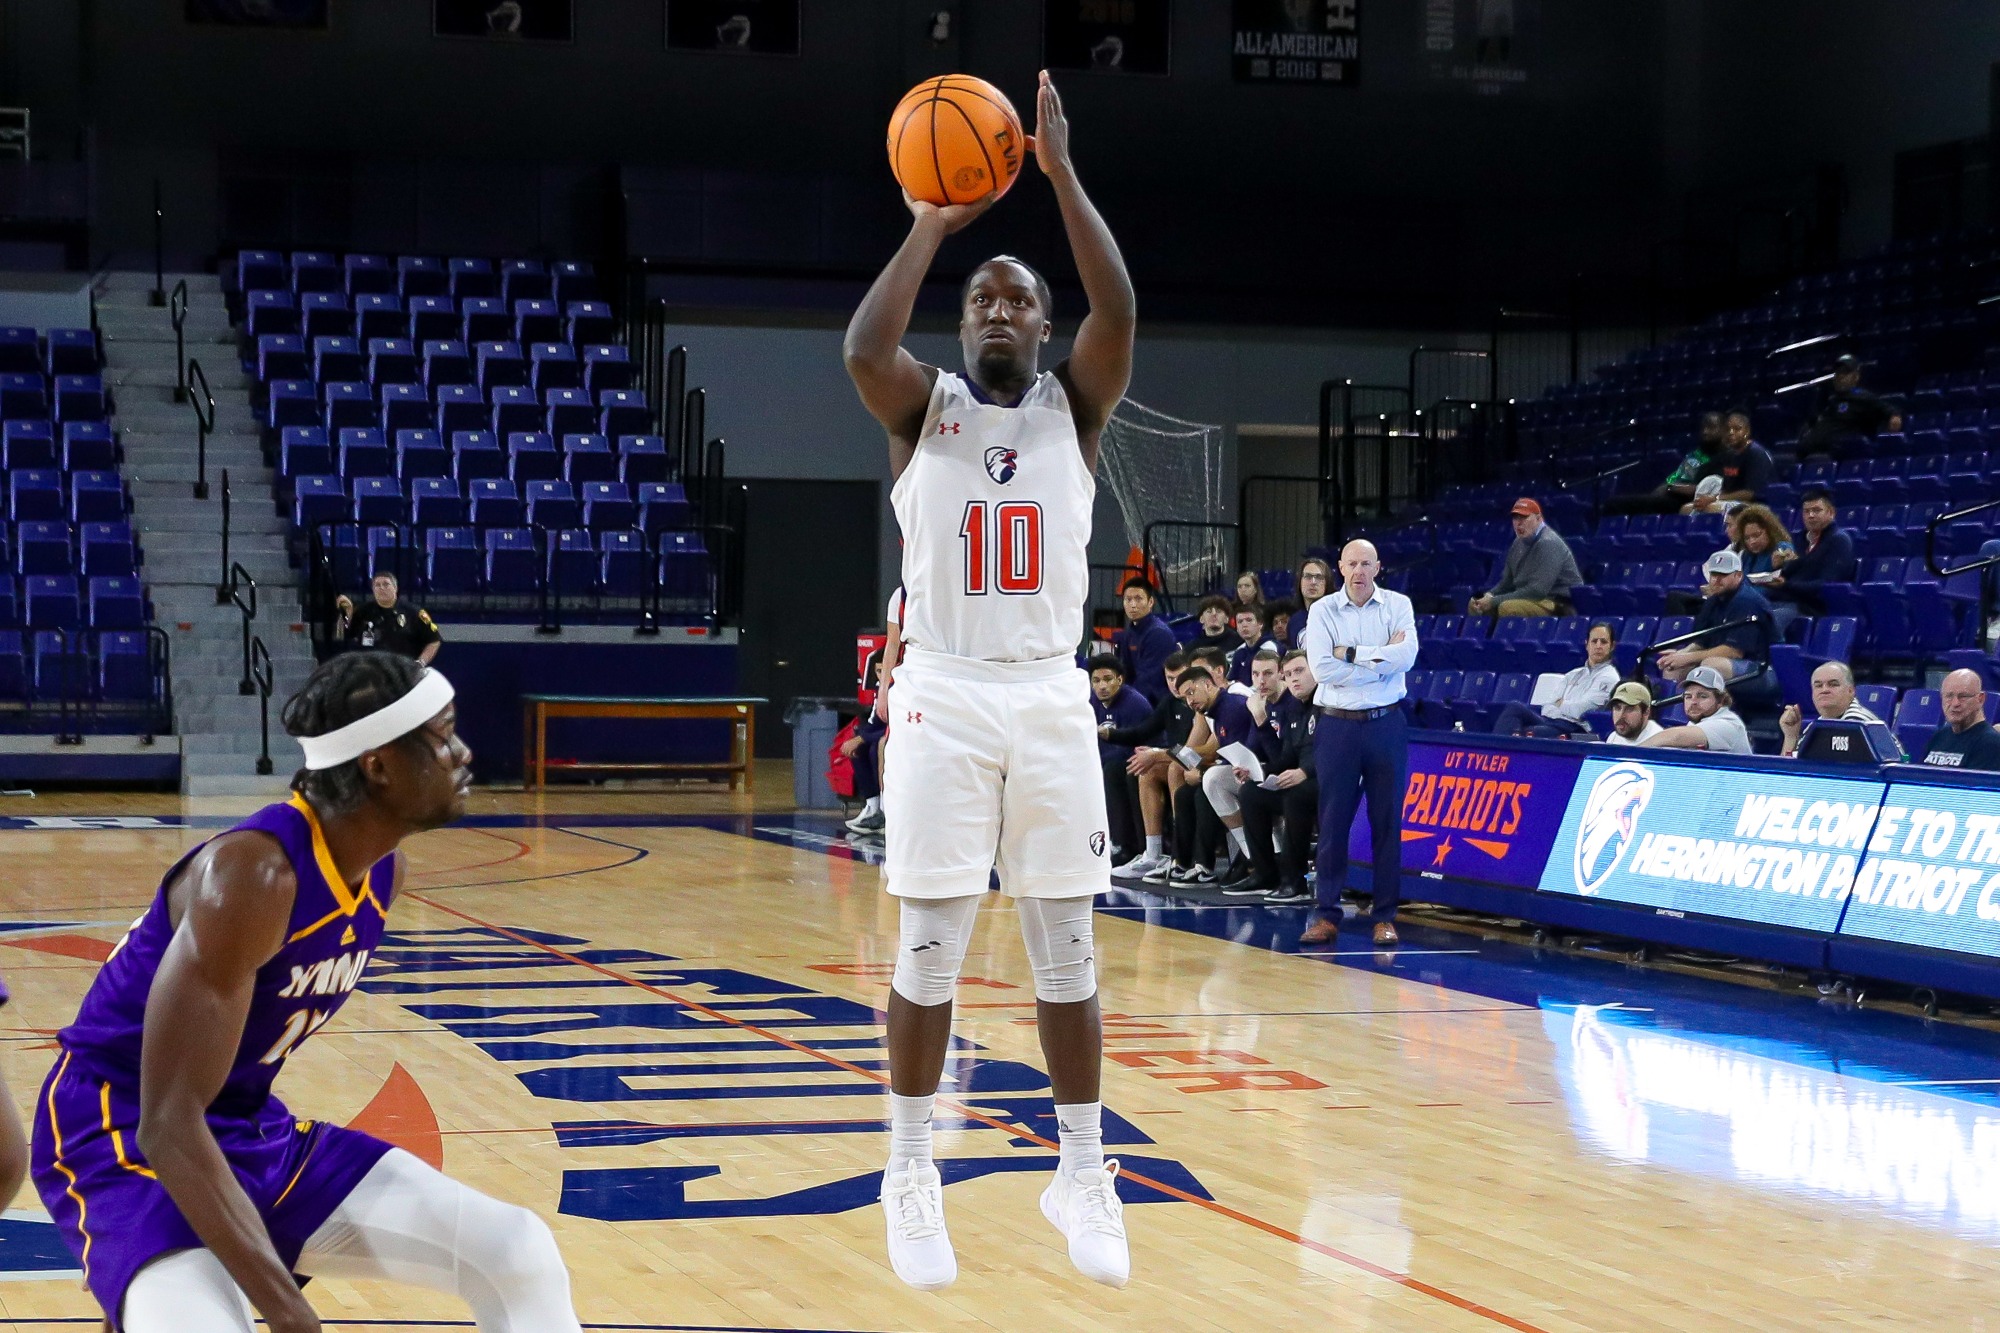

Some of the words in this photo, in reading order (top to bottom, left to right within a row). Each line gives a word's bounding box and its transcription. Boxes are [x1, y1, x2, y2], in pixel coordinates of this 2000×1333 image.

[959, 500, 1044, 596] 10
[1445, 752, 1464, 768] UT
[1466, 753, 1510, 772] TYLER
[1832, 736, 1849, 751] POSS
[1402, 772, 1532, 835] PATRIOTS
[1734, 793, 1907, 852] WELCOME
[1901, 808, 1956, 858] TO
[1628, 832, 1830, 897] HERRINGTON
[1819, 854, 1983, 915] PATRIOT
